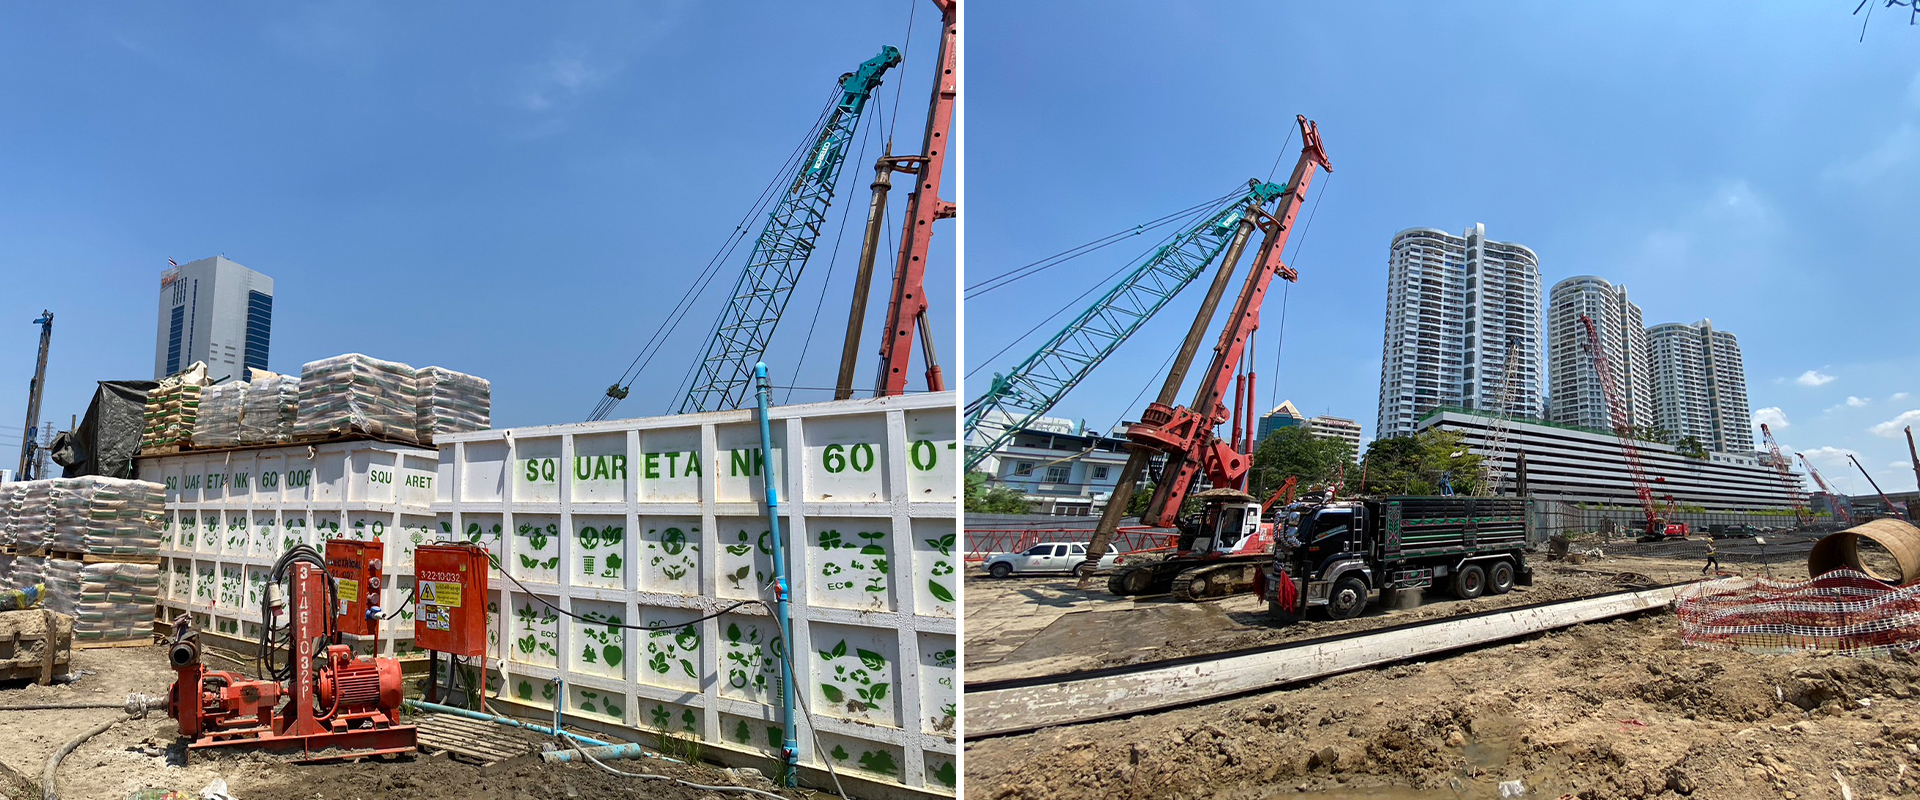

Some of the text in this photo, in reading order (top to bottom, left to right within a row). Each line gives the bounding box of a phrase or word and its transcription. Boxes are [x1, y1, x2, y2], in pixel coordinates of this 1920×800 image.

[526, 458, 555, 482] SQ
[822, 443, 874, 473] 60
[262, 471, 278, 488] 60
[828, 581, 853, 590] ECO
[541, 630, 557, 638] ECO
